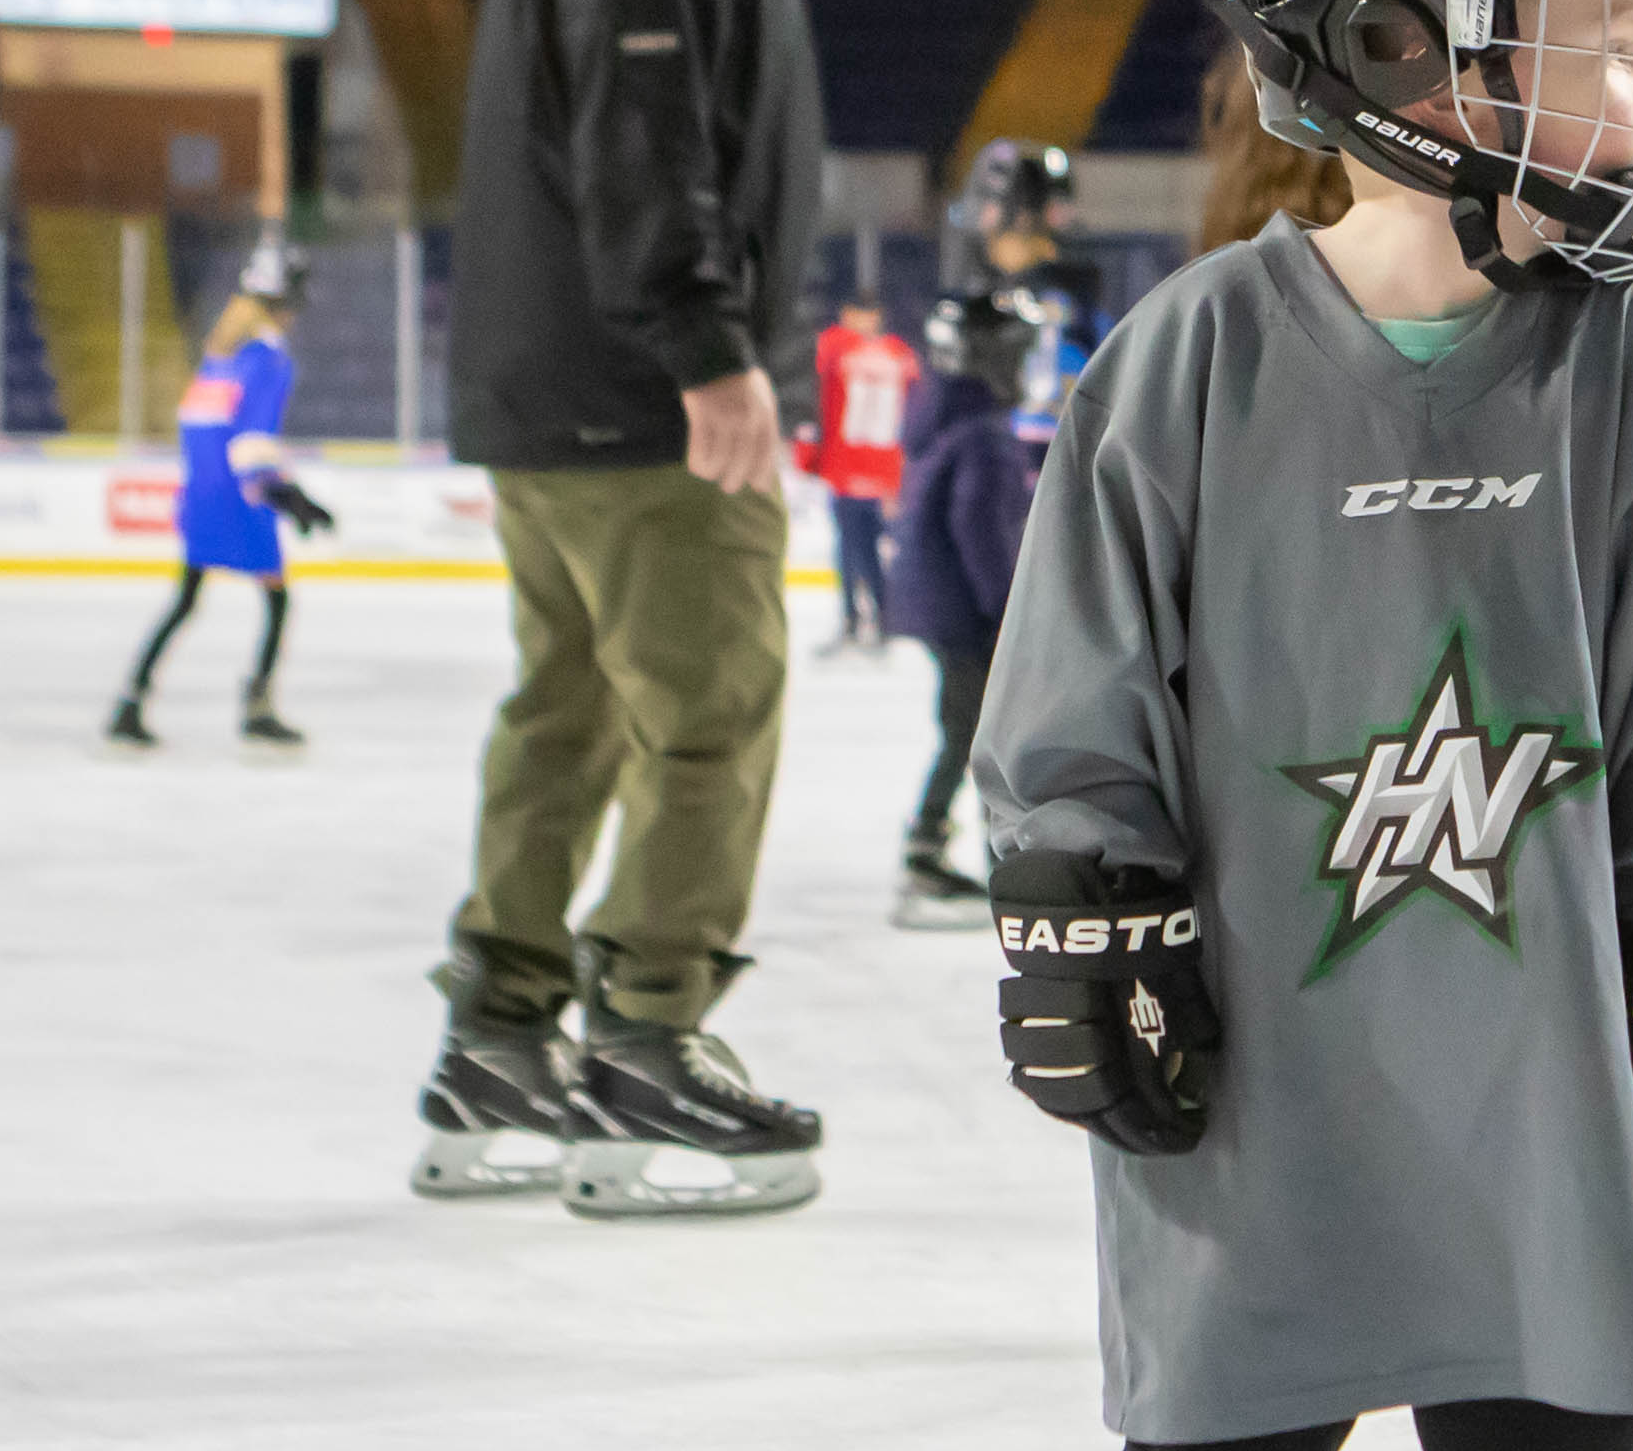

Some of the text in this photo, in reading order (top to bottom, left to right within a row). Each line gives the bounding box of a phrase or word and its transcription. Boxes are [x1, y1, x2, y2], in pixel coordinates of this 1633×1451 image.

[1354, 110, 1462, 167] BAUER
[1341, 472, 1543, 517] CCM
[1000, 905, 1201, 954] EASTO
